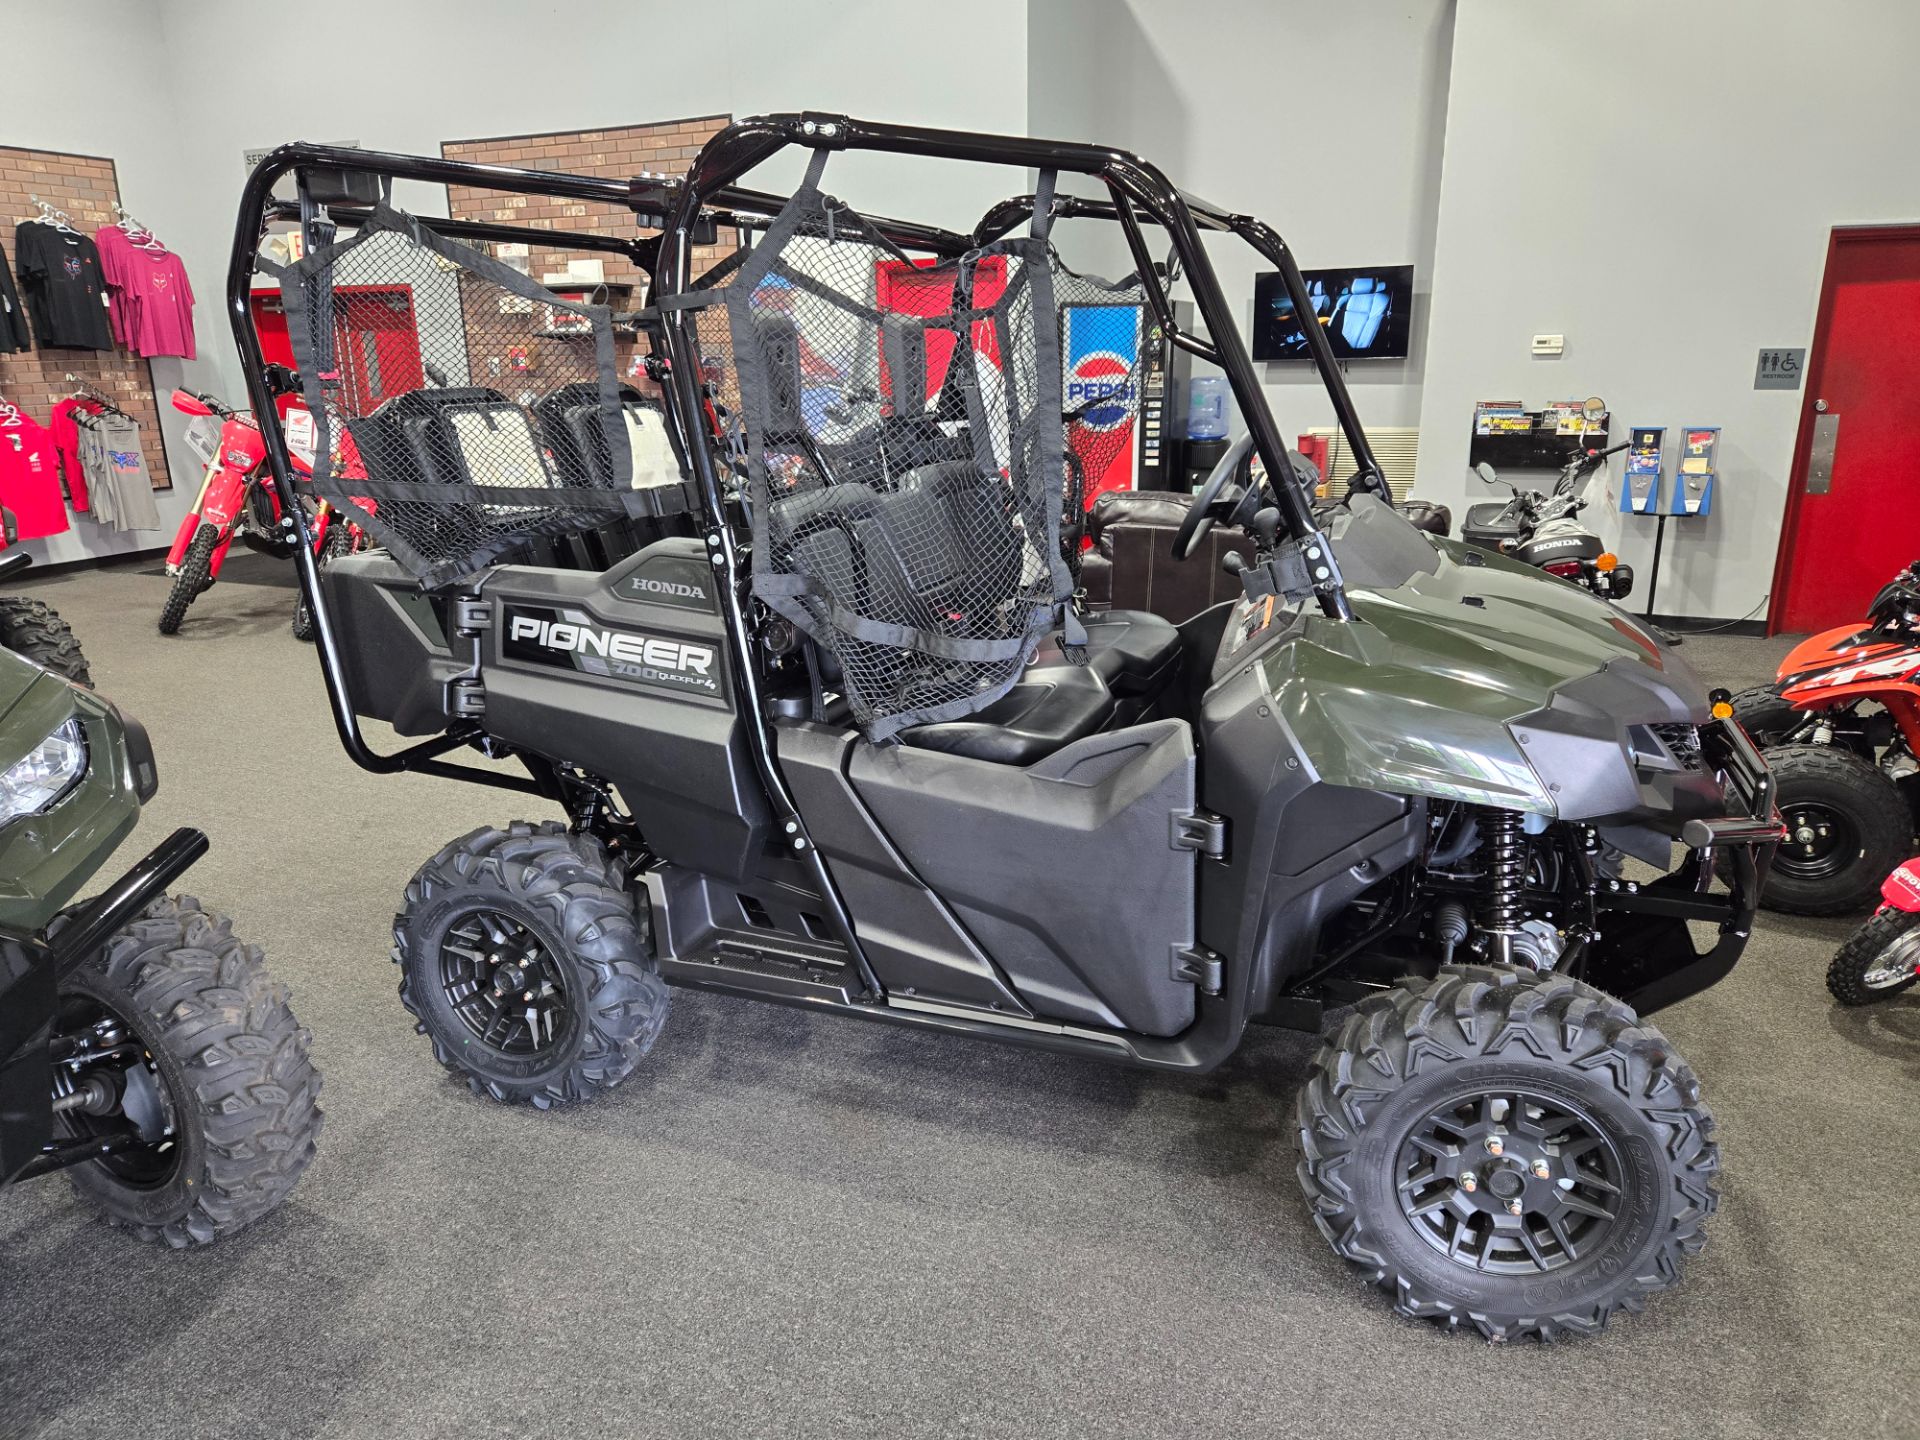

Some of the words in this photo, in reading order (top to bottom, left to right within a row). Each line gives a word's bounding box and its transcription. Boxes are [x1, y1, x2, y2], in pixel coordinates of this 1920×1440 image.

[1069, 383, 1136, 401] PEPSI
[1534, 539, 1583, 553] HONDA
[632, 577, 706, 600] HONDA
[511, 616, 712, 674] PIONEER
[615, 660, 658, 680] 700
